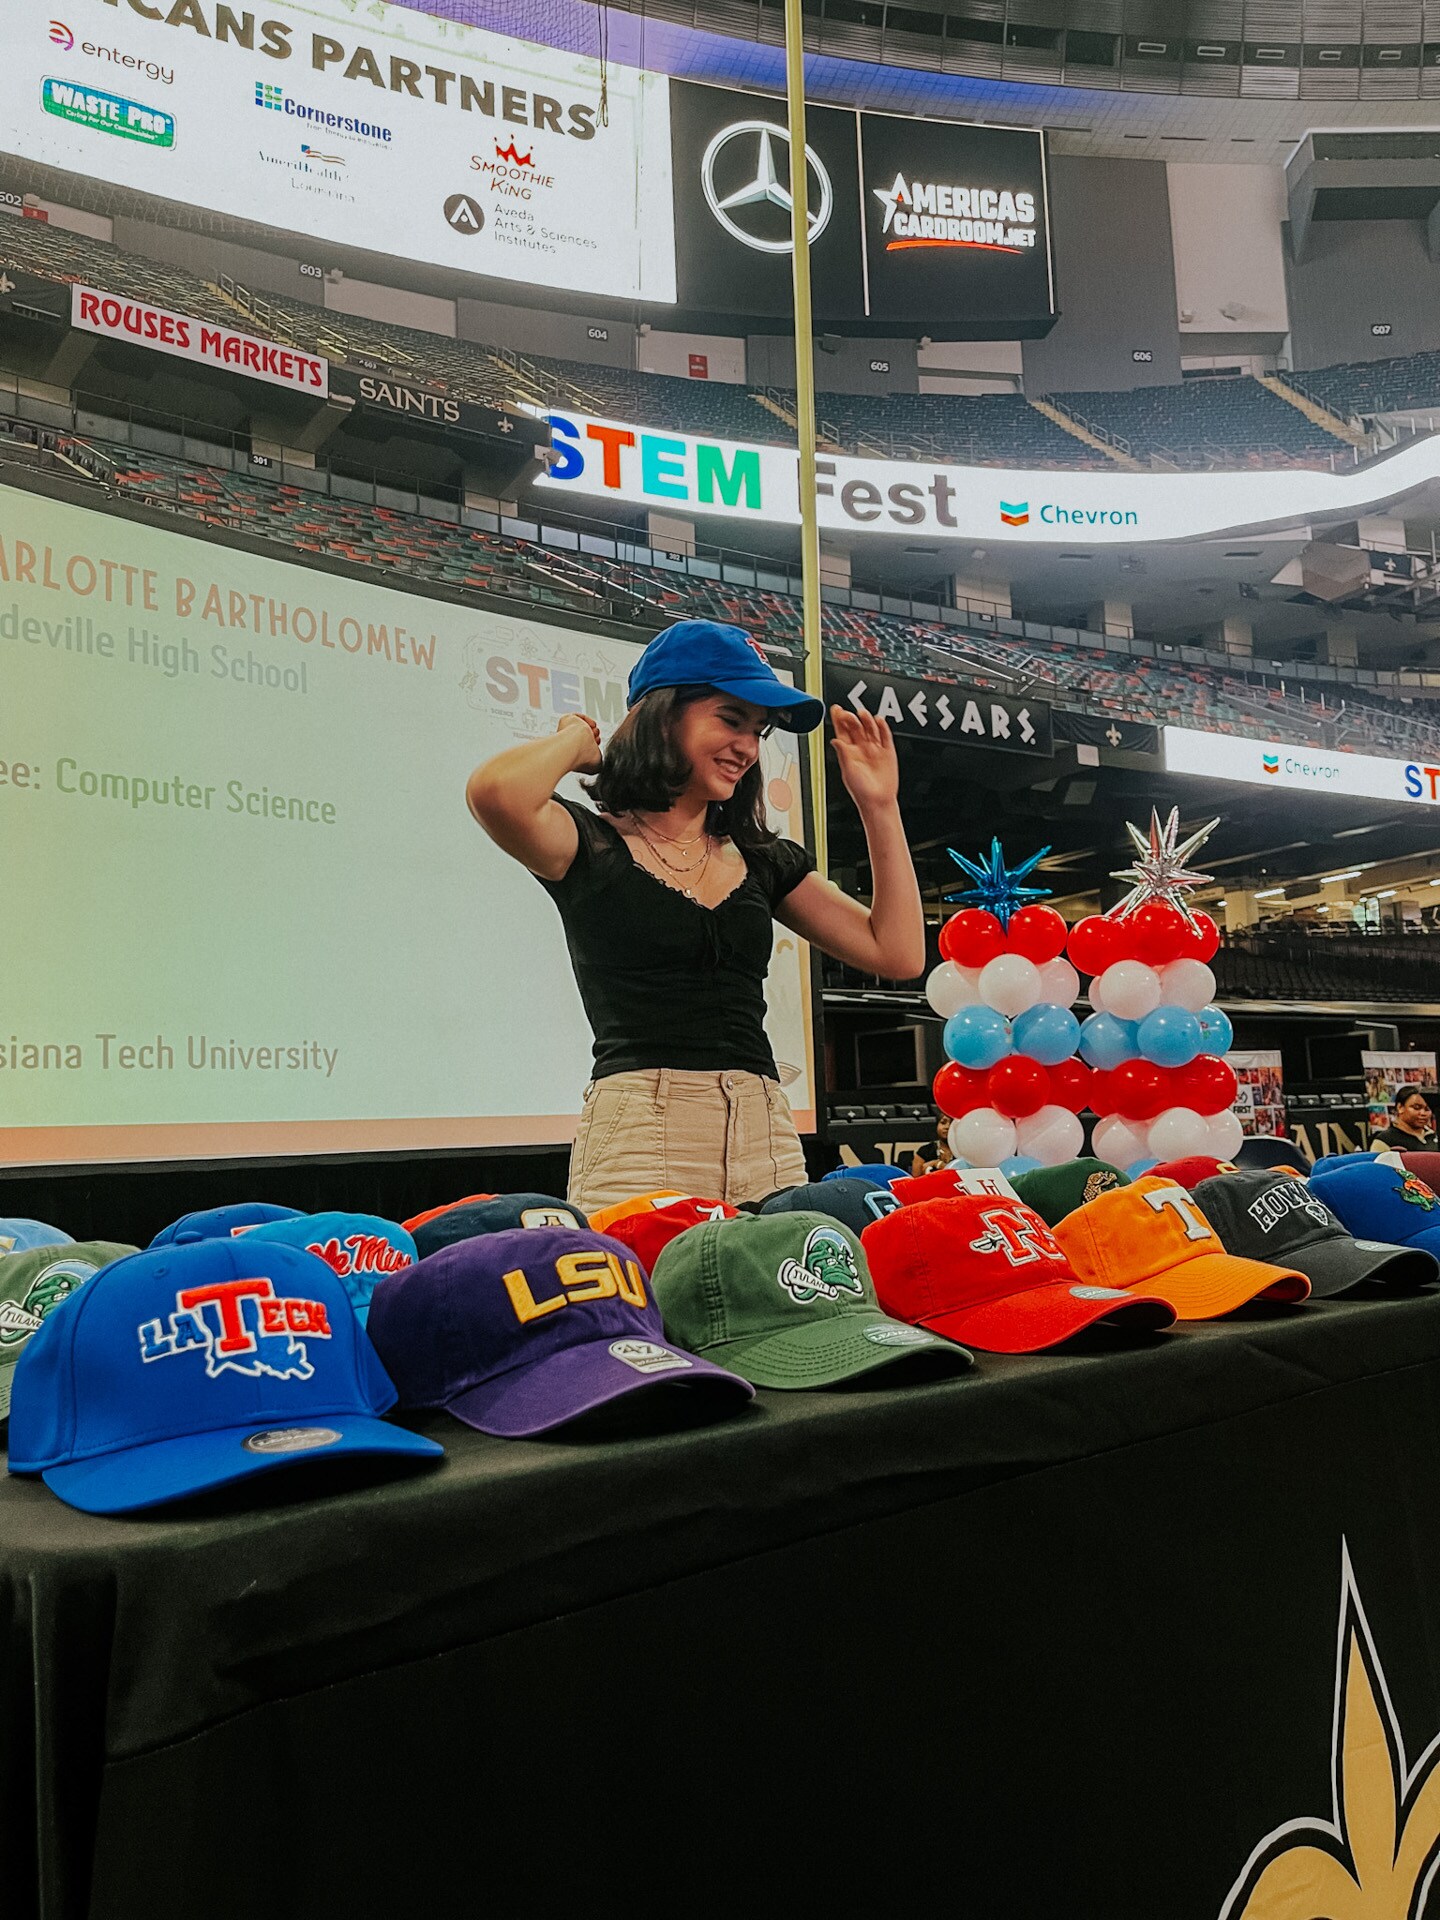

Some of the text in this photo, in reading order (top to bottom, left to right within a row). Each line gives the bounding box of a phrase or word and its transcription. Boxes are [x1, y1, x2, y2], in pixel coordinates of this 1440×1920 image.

[81, 41, 174, 85] entergy
[95, 0, 597, 141] CANS PARTNERS
[51, 82, 166, 135] WASTE PRO
[284, 98, 392, 142] Cornerstone
[469, 155, 556, 189] SMOOTHIE
[494, 203, 534, 222] Aveda
[873, 172, 1036, 223] AMERICAS
[494, 217, 598, 250] Arts & Sciences
[494, 231, 556, 255] Institutes
[893, 211, 1037, 248] CARDROOM.NET
[300, 264, 322, 279] 603
[80, 292, 323, 388] ROUSES MARKETS
[588, 328, 608, 341] 604
[1373, 325, 1391, 336] 607
[870, 361, 889, 372] 605
[1134, 351, 1152, 362] 606
[359, 377, 461, 423] SAINTS
[253, 455, 269, 467] 301
[541, 415, 958, 529] STEM Fest
[1040, 504, 1139, 526] Chevron
[175, 577, 437, 671] BARTHOLOMEW
[128, 626, 199, 678] High
[210, 644, 308, 695] School
[485, 655, 625, 725] STEM
[1285, 758, 1341, 779] Chevron
[56, 757, 216, 809] Computer
[226, 780, 336, 825] Science
[95, 1033, 174, 1070] Tech
[187, 1035, 339, 1078] University
[1143, 1186, 1213, 1242] T
[502, 1251, 648, 1325] LSU
[793, 1269, 827, 1290] TULANE
